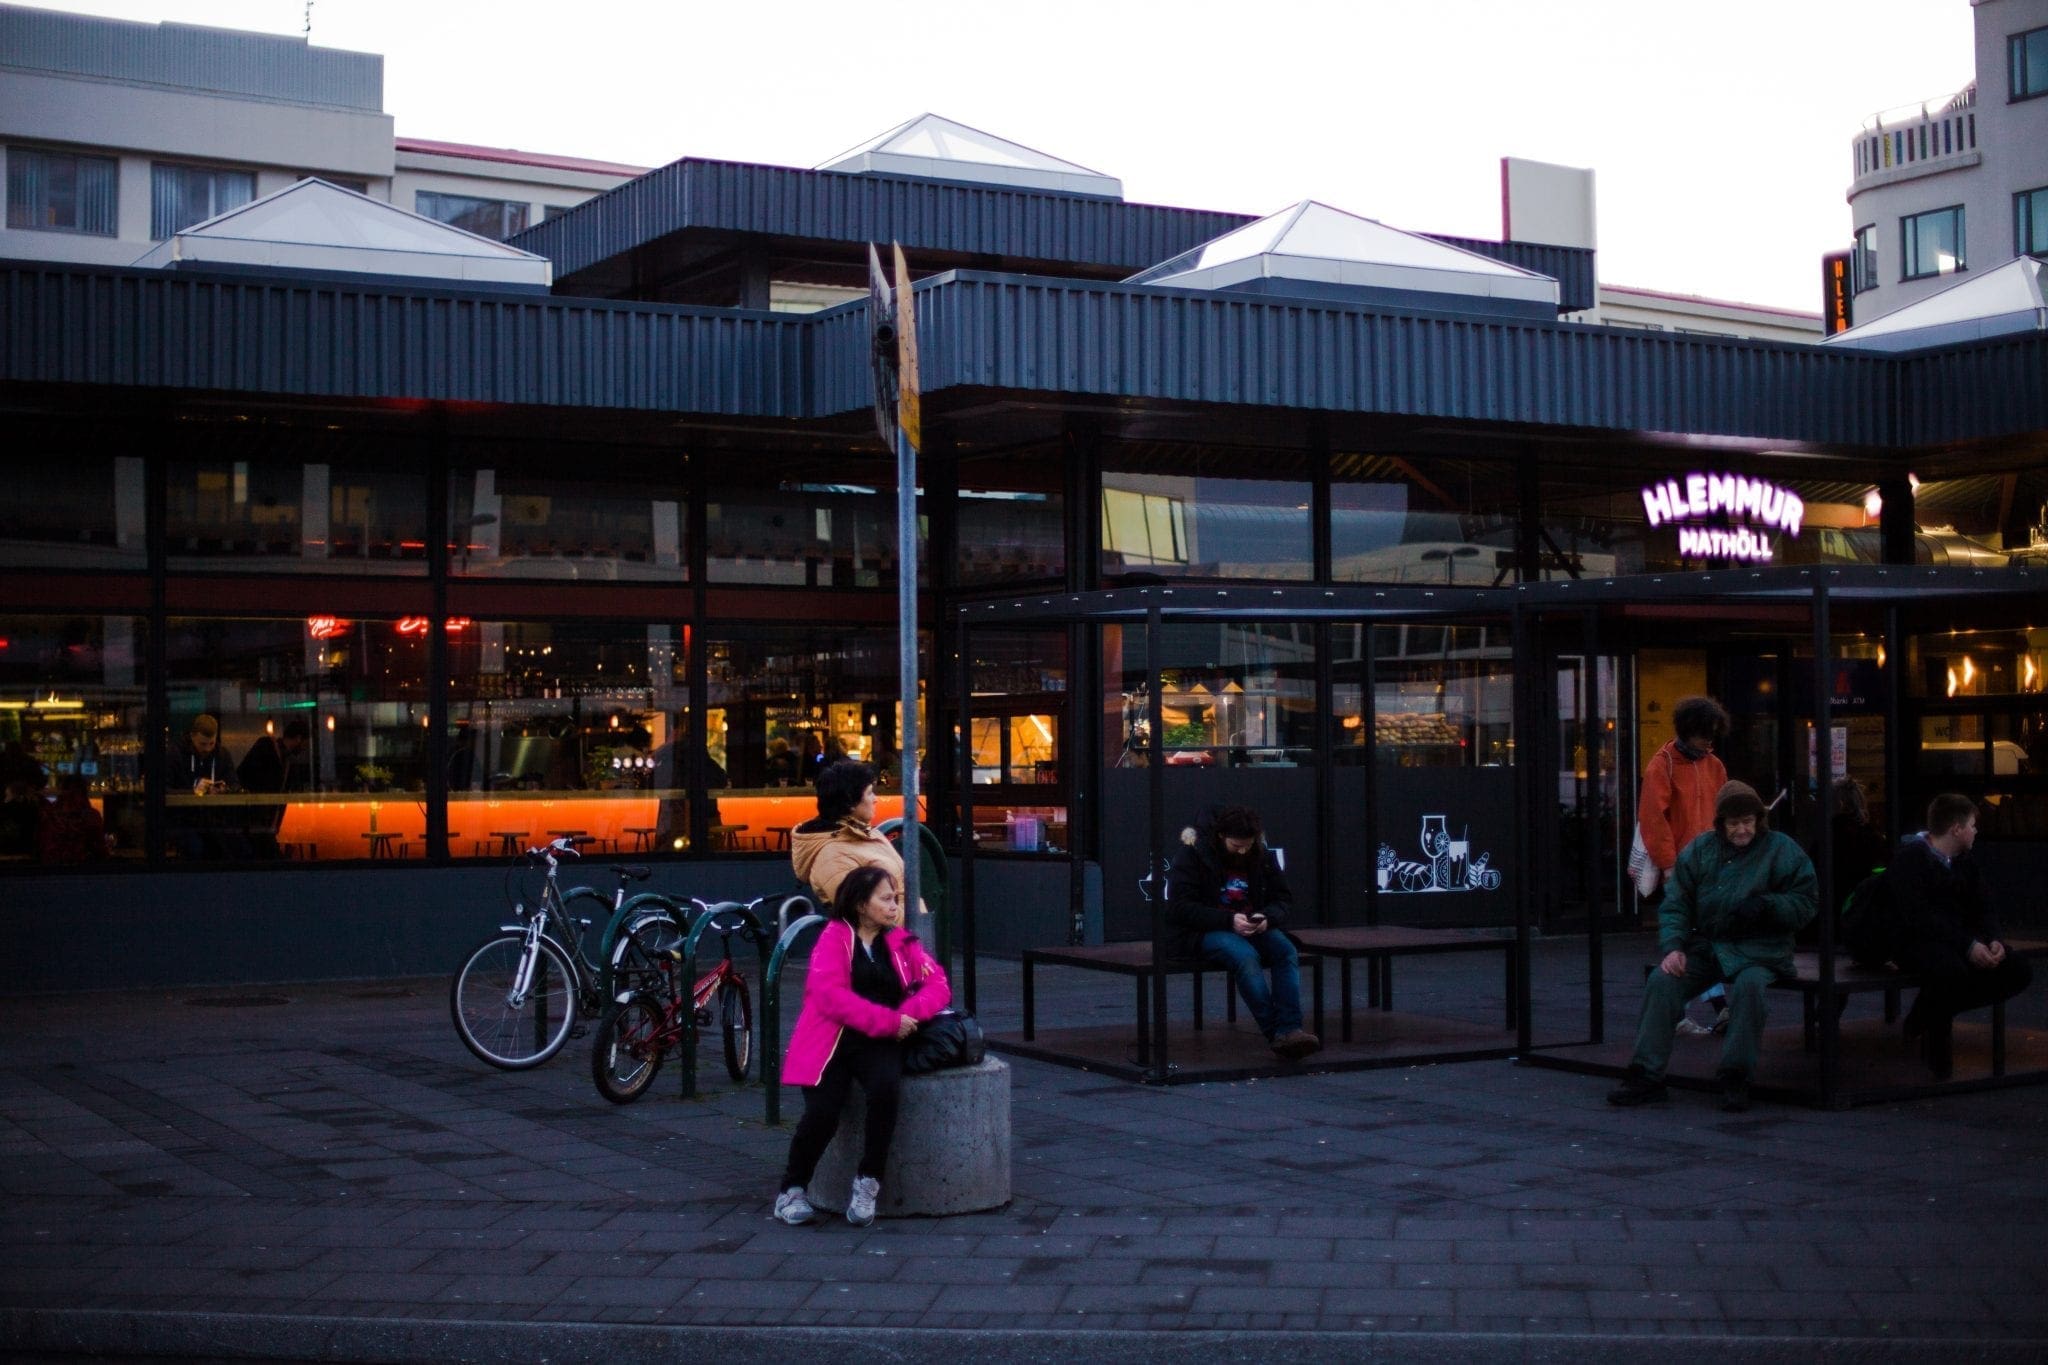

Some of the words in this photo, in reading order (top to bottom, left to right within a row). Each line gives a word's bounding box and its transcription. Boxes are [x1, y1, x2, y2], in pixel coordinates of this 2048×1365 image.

[1834, 260, 1846, 333] HLEM
[1642, 472, 1804, 537] HLEMMUR
[1679, 526, 1773, 560] MATHÖLL
